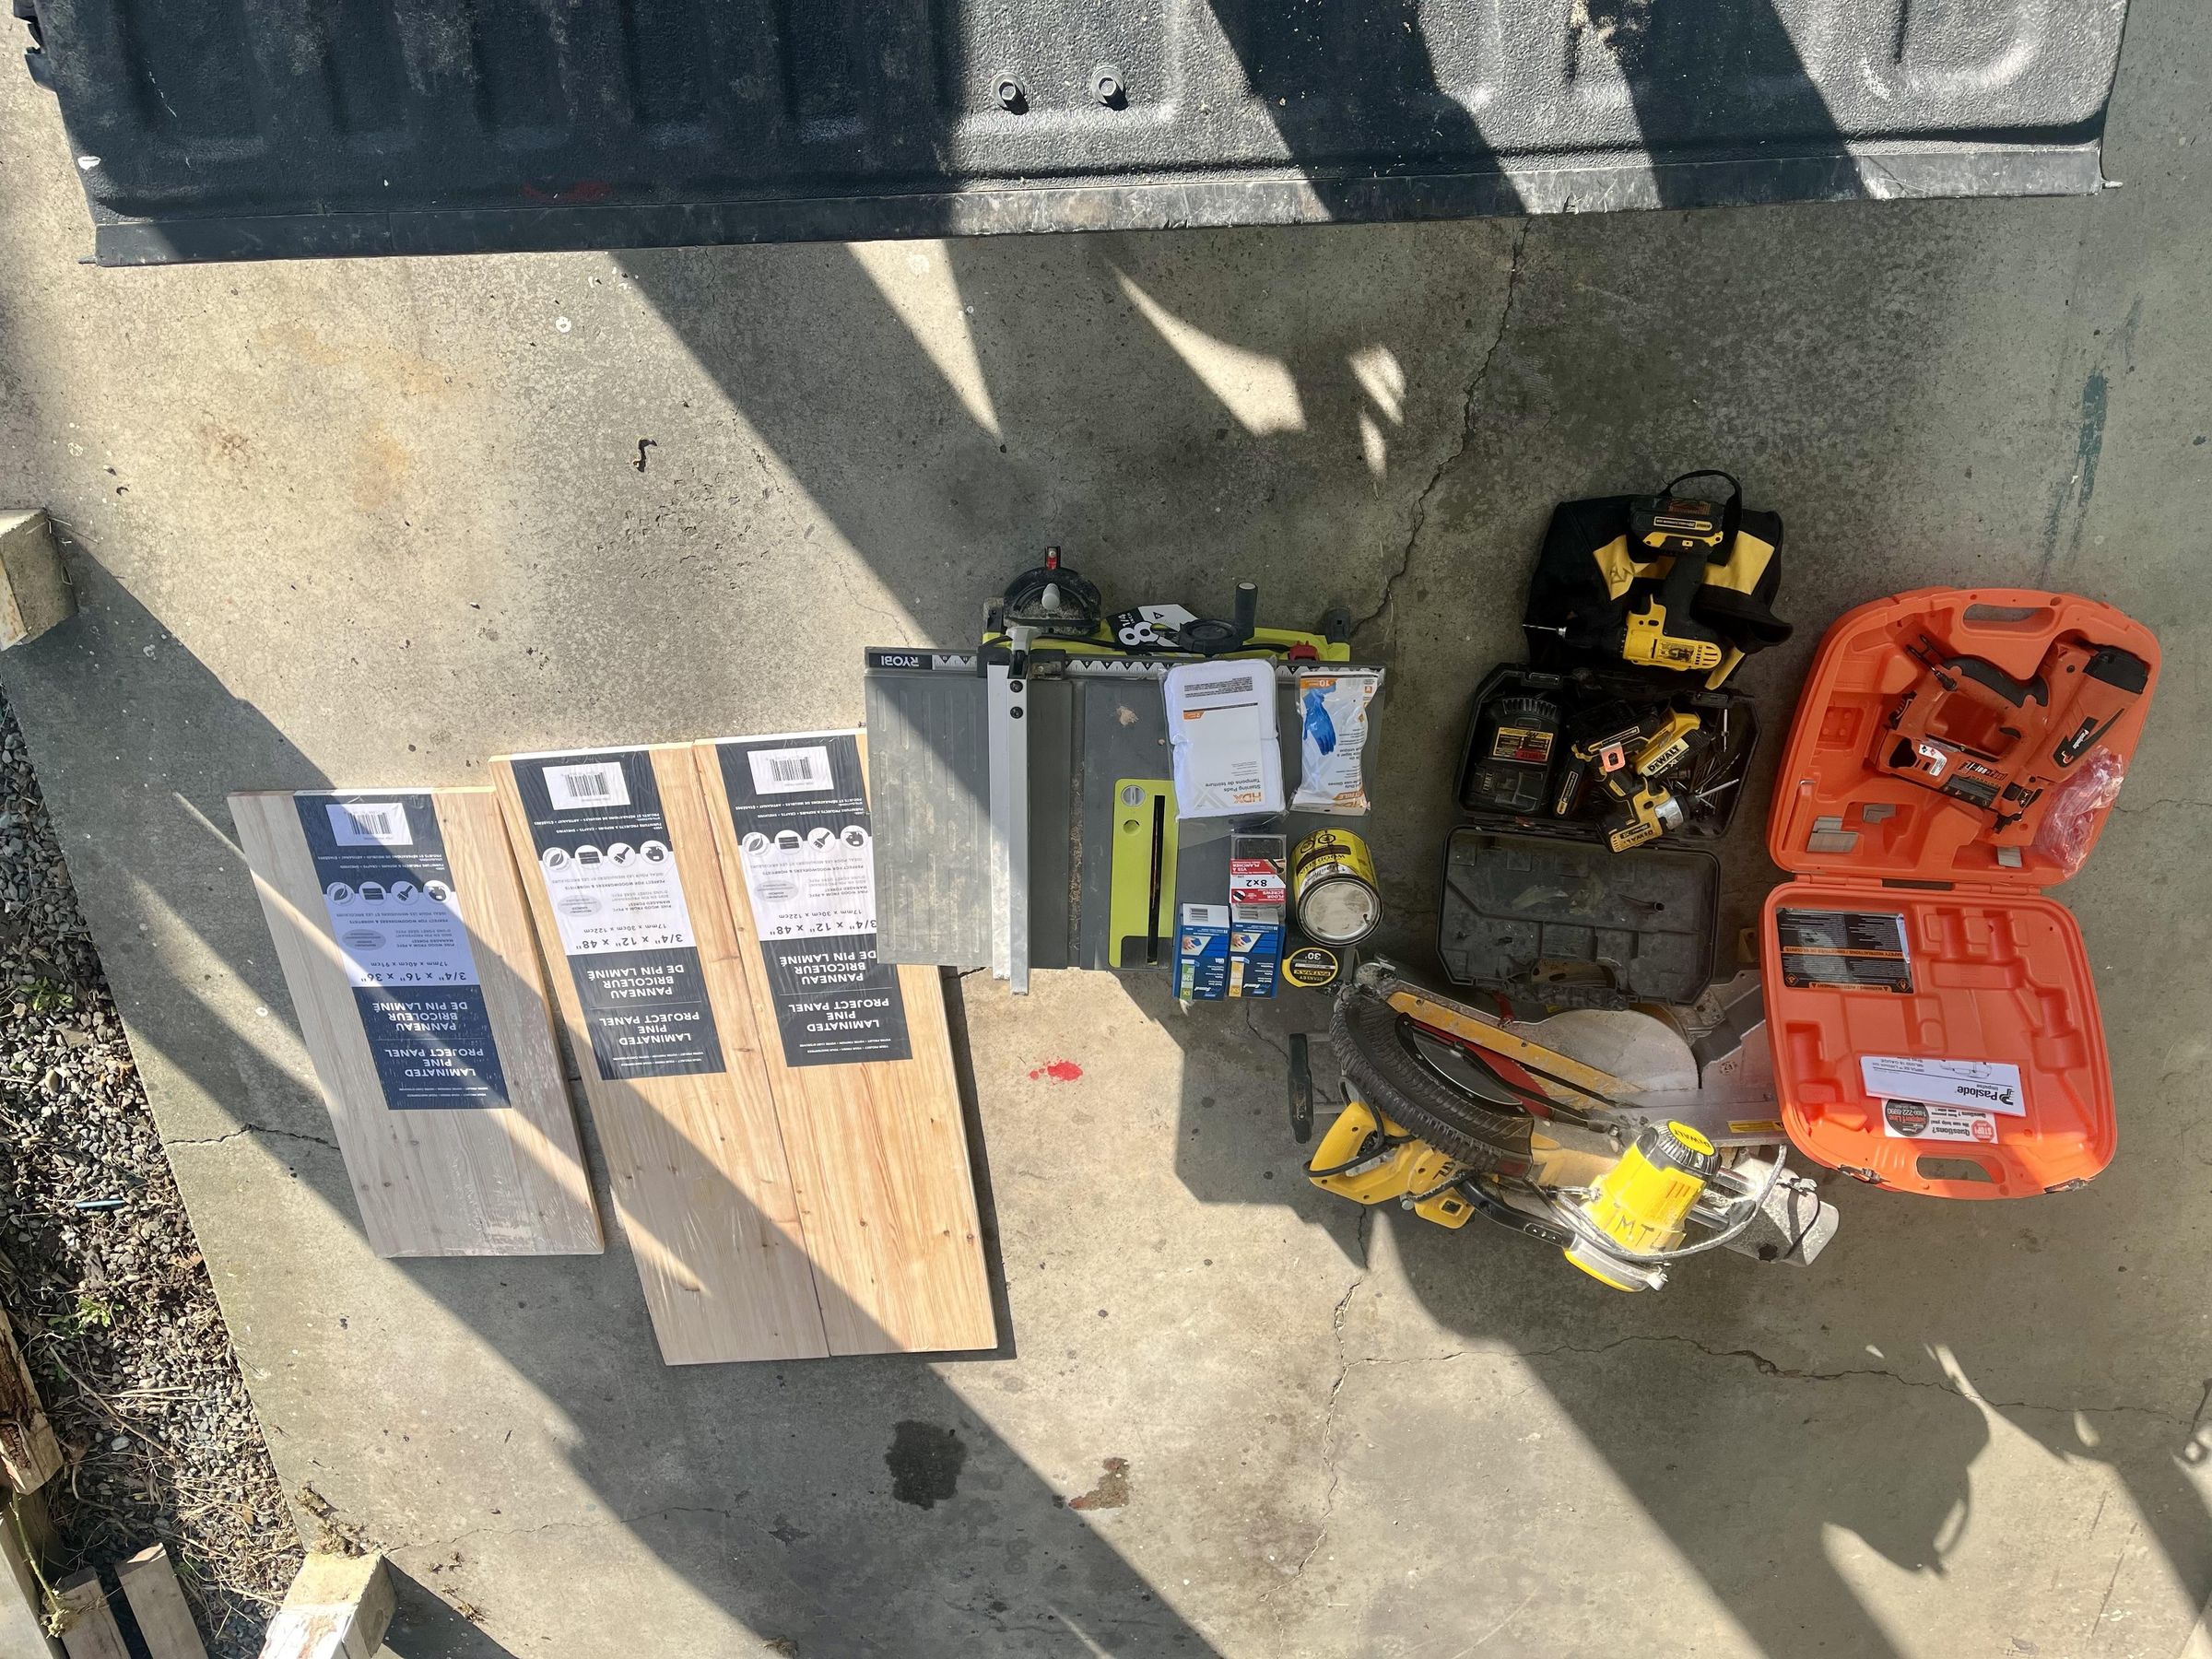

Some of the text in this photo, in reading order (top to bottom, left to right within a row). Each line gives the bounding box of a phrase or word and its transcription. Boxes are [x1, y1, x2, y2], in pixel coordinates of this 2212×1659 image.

[1117, 613, 1159, 646] 8 1/4
[880, 655, 920, 667] RYOBI
[1319, 679, 1330, 688] 10
[1647, 745, 1682, 772] DEWALT
[1238, 783, 1261, 792] Staining
[1232, 792, 1262, 804] HDX
[1623, 830, 1654, 844] DEWALT
[1317, 854, 1346, 863] WOOD
[770, 925, 793, 935] 48"
[809, 923, 831, 932] 12"
[849, 919, 877, 930] 3/4"
[575, 940, 597, 949] 48"
[615, 936, 637, 947] 12"
[654, 934, 683, 944] 3/4"
[779, 950, 877, 967] DE PIN LAMINÉ
[1304, 952, 1322, 960] 30'
[586, 964, 684, 981] DE PIN LAMINÉ
[794, 962, 865, 974] BRICOLEUR
[360, 973, 382, 982] 36"
[399, 972, 420, 981] 16"
[438, 971, 466, 981] 3/4"
[801, 973, 864, 985] PANNEAU
[602, 976, 674, 988] BRICOLEUR
[610, 986, 673, 998] PANNEAU
[371, 1002, 468, 1013] DE PIN LAMINÉ
[788, 998, 889, 1013] PROJECT PANEL
[388, 1012, 458, 1021] BRICOLEUR
[599, 1011, 700, 1026] PROJECT PANEL
[826, 1011, 856, 1021] PINE
[395, 1022, 456, 1031] PANNEAU
[637, 1025, 667, 1033] PINE
[806, 1019, 880, 1032] LAMINATED
[618, 1032, 691, 1045] LAMINATED
[384, 1048, 484, 1057] PROJECT PANEL
[422, 1059, 452, 1067] PINE
[404, 1068, 477, 1077] LAMINATED
[1957, 1086, 1998, 1100] Paslode
[1932, 1127, 1971, 1136] Questions?
[1674, 1129, 1711, 1148] DEWALT
